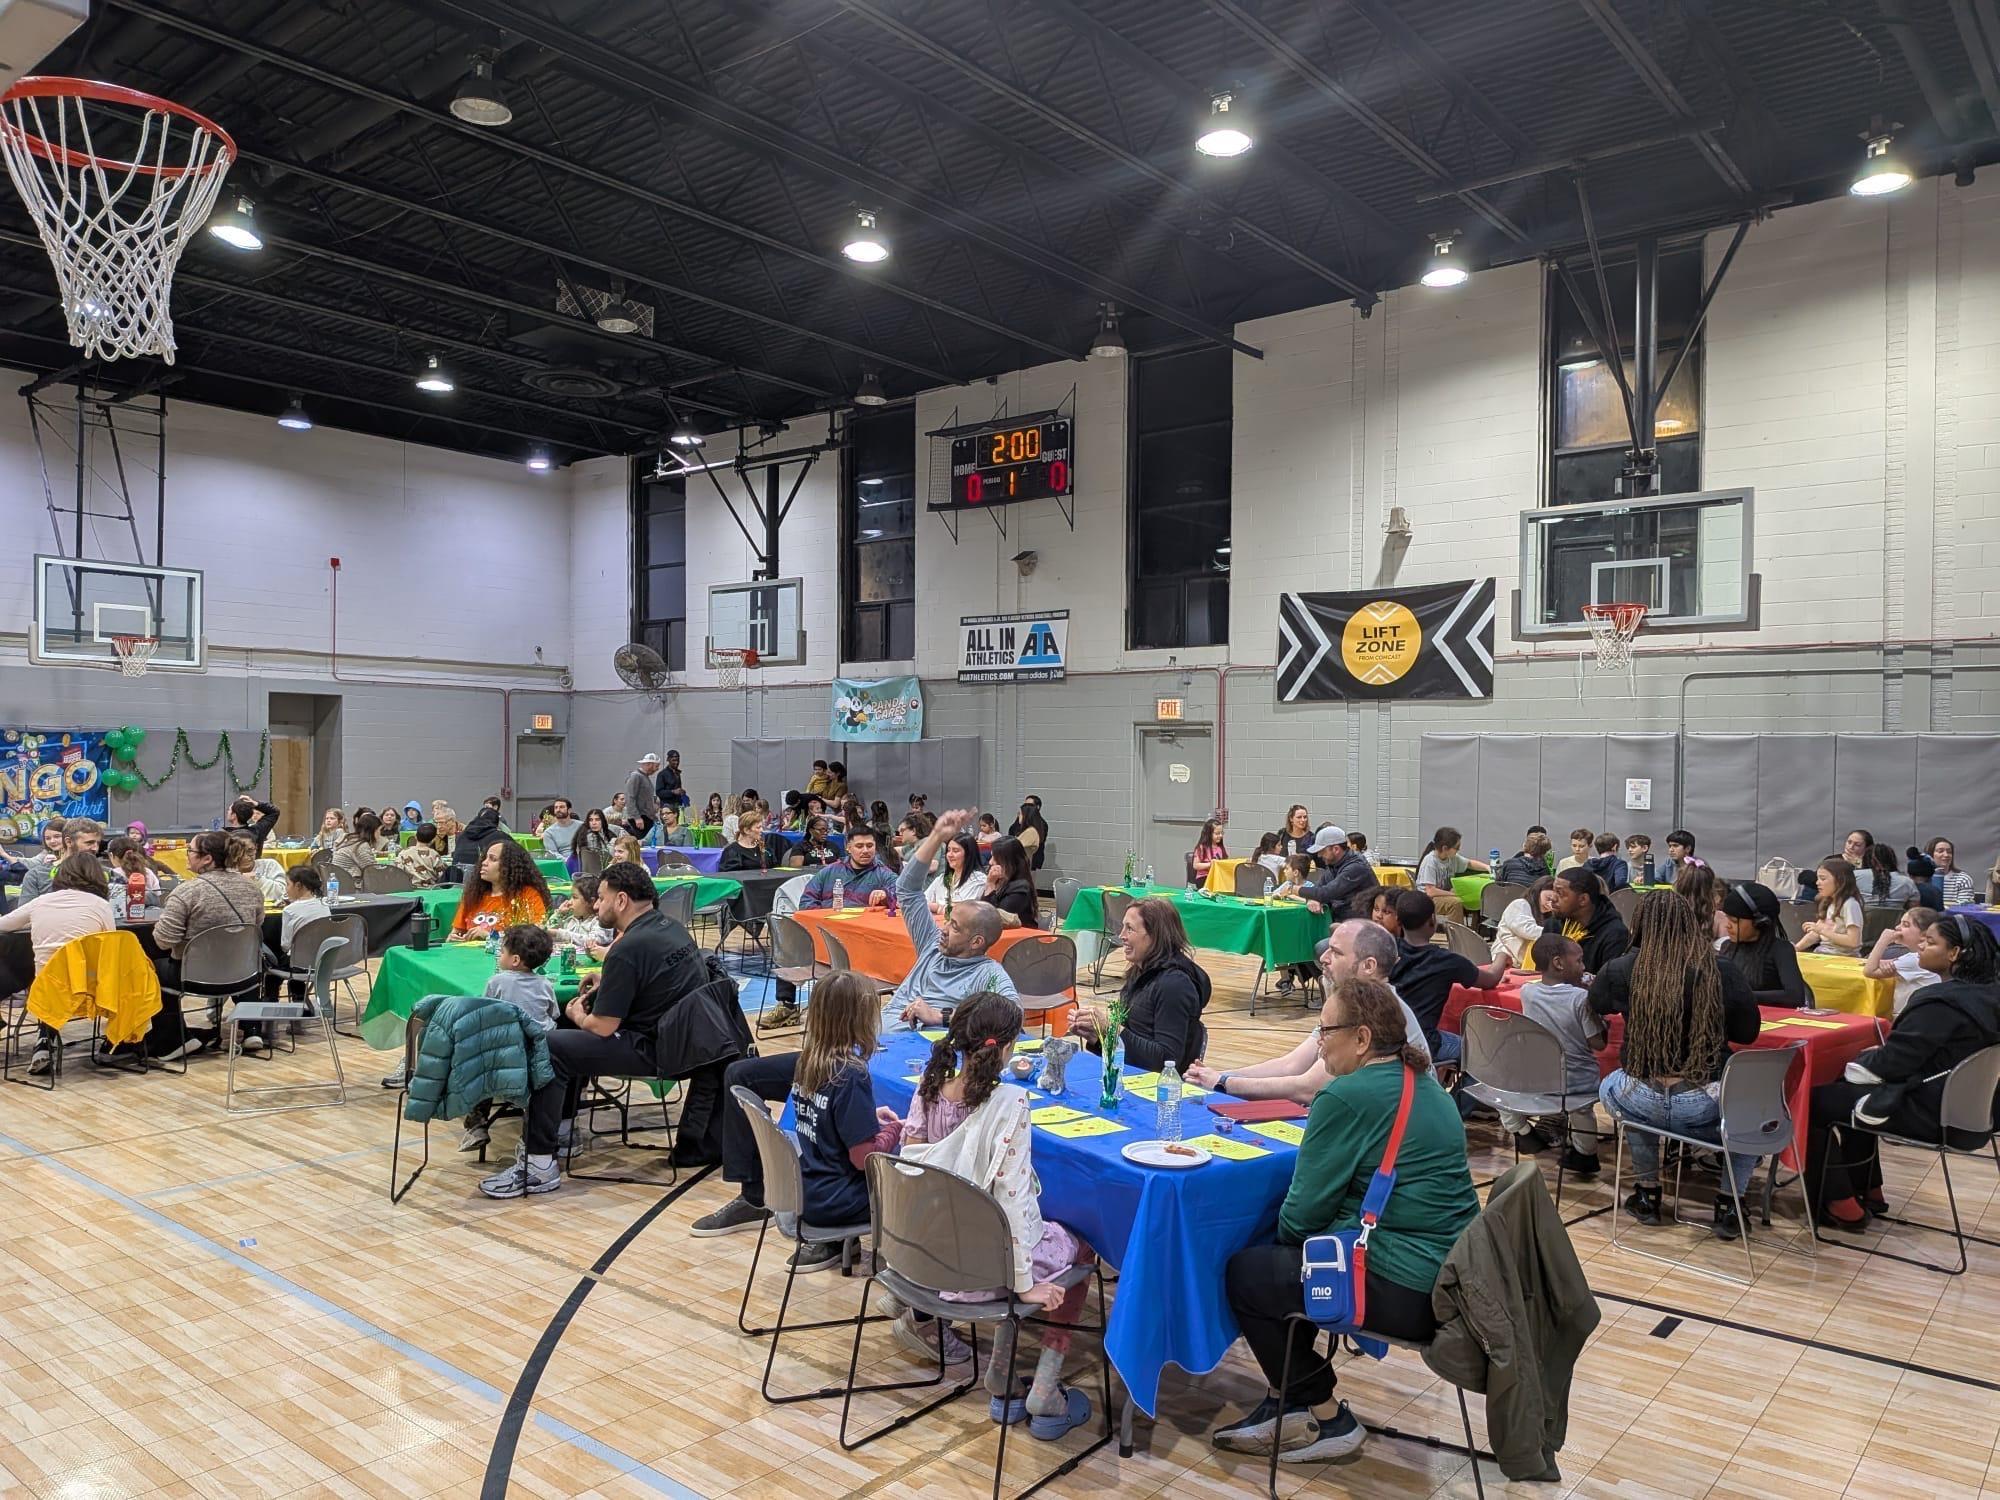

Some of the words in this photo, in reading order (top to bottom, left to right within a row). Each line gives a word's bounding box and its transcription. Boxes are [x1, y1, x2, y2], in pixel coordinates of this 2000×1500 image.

[992, 429, 1039, 463] 2:00
[954, 464, 976, 476] HOME
[1050, 461, 1066, 491] 0
[967, 474, 981, 501] 0
[1009, 471, 1015, 496] 1
[967, 629, 994, 651] ALL
[999, 627, 1015, 650] IN
[1363, 625, 1401, 639] LIFT
[1355, 640, 1406, 653] ZONE
[966, 651, 1015, 666] ATHLETICS
[1029, 671, 1049, 680] adidas
[871, 698, 904, 711] PANDA
[1161, 702, 1177, 716] EXIT
[875, 704, 907, 721] CARES
[538, 717, 549, 727] EXIT
